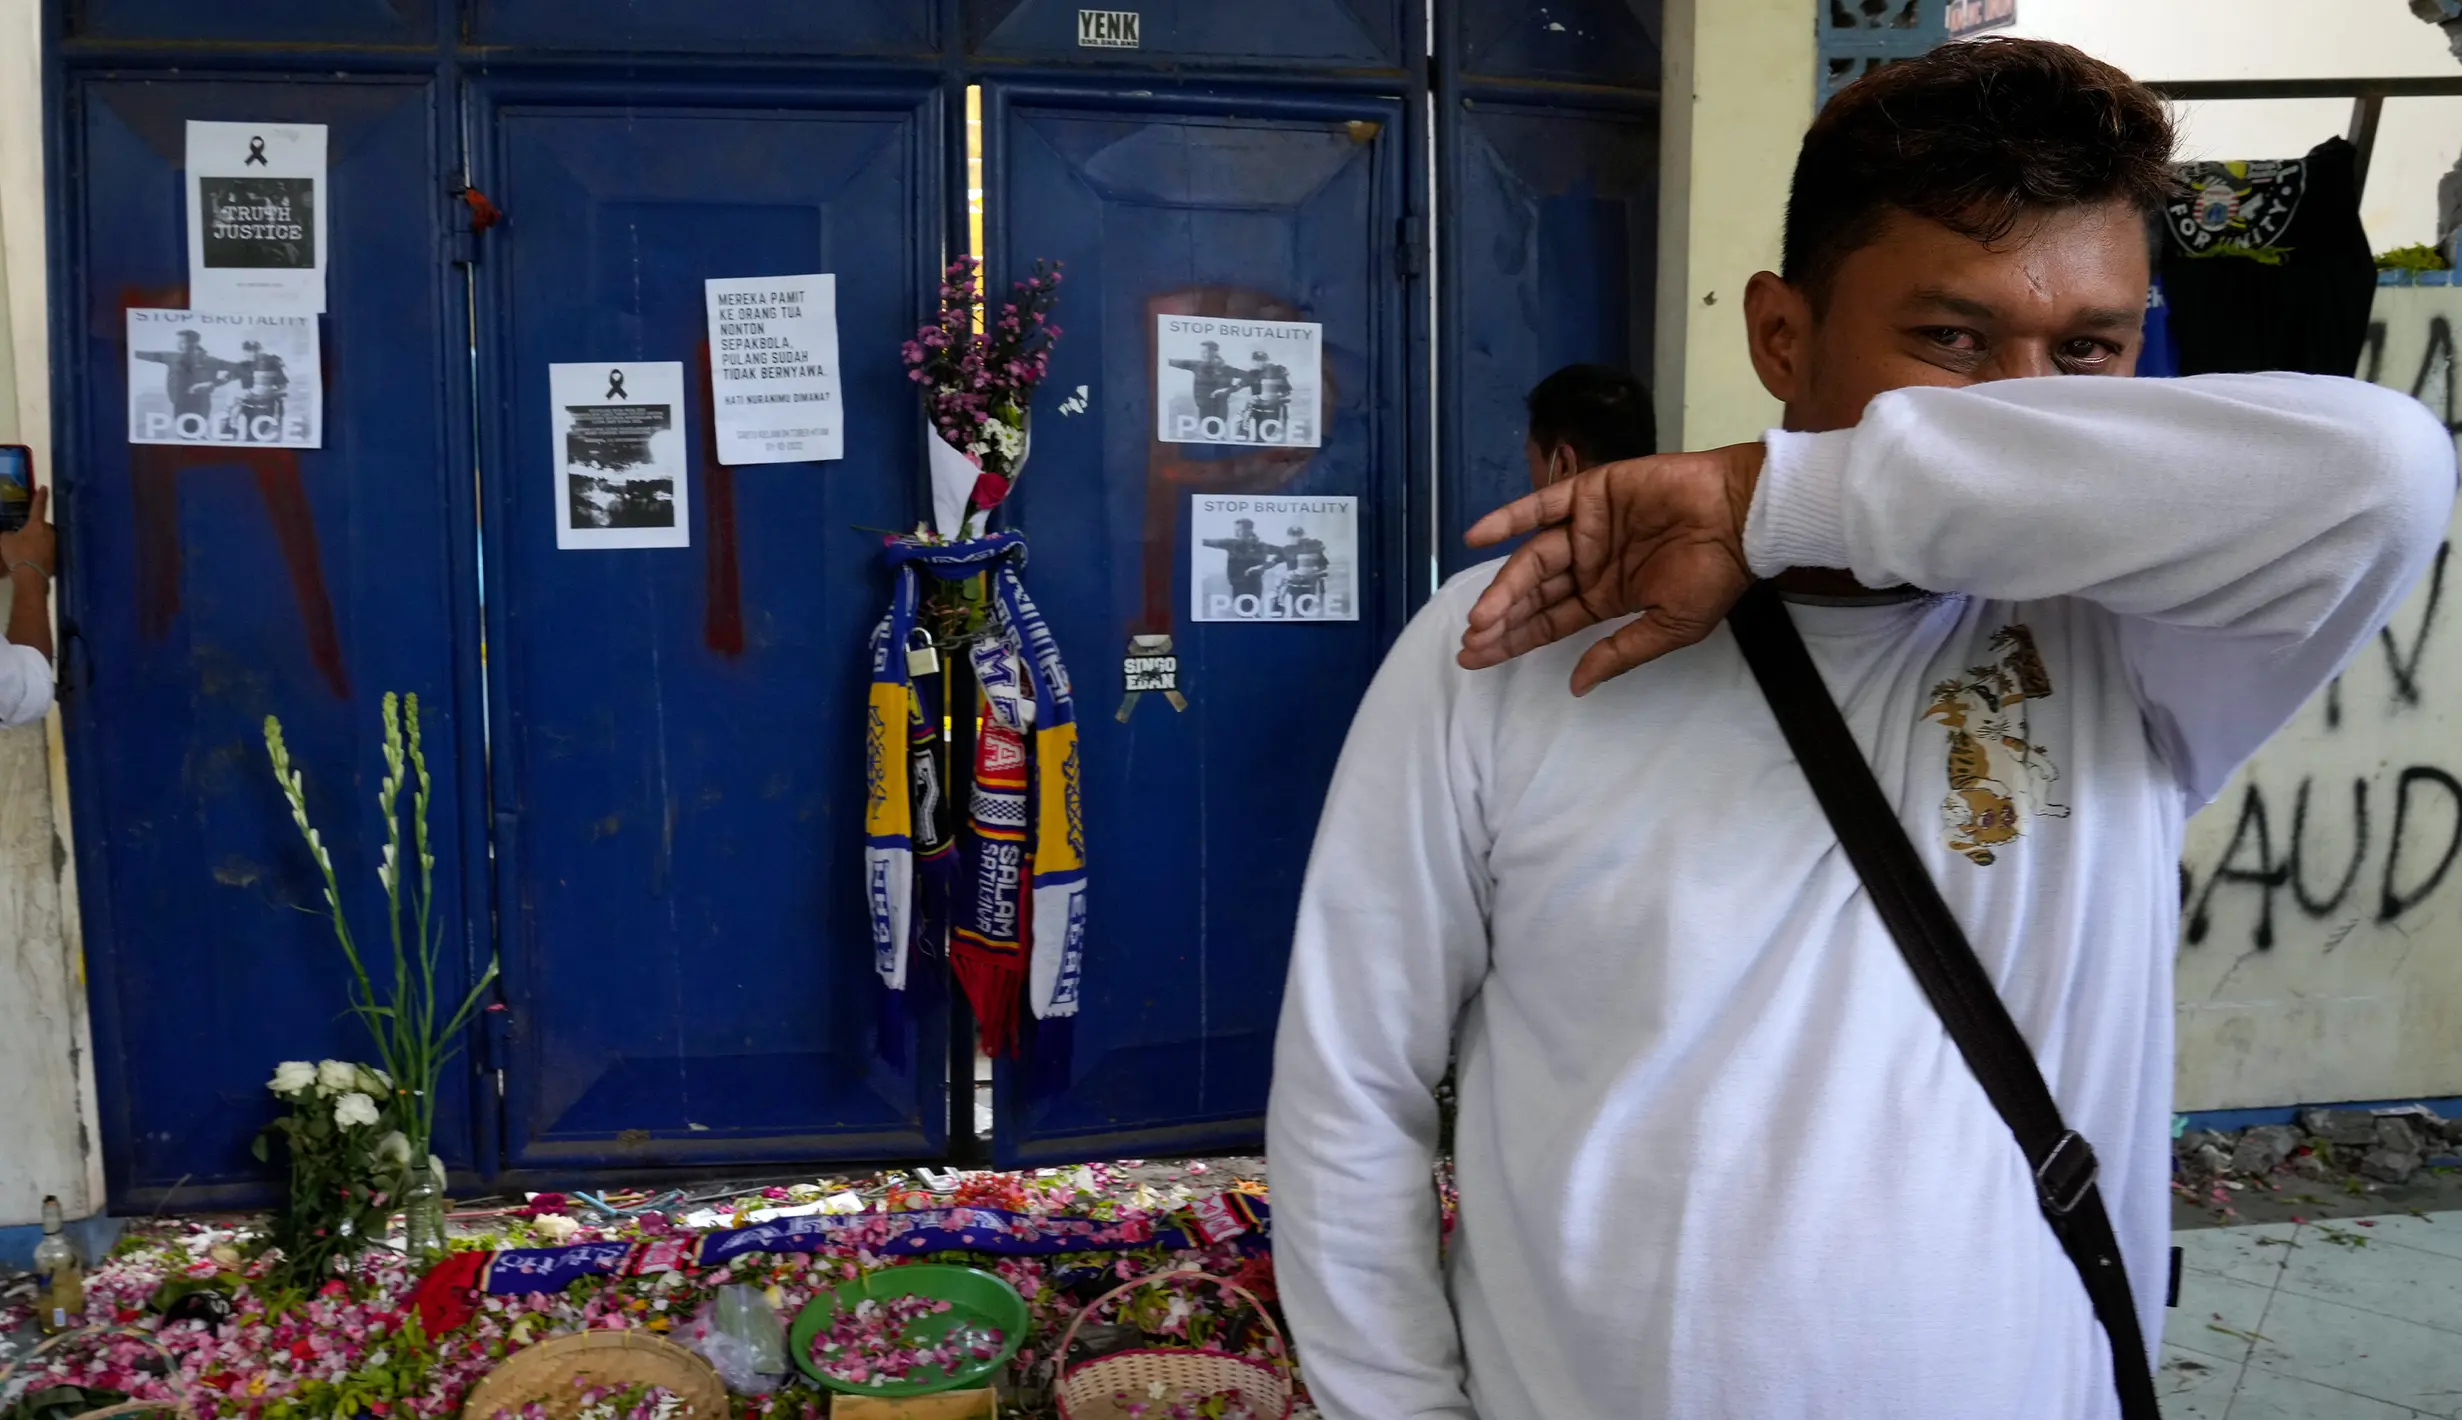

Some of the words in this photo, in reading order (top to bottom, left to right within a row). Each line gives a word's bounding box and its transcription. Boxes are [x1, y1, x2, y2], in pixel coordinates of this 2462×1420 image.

[1080, 12, 1138, 40] YENK
[221, 205, 292, 222] TRUTH
[213, 223, 303, 240] JUSTICE
[2169, 203, 2212, 249] FOR
[718, 292, 767, 306] MEREKA
[771, 290, 805, 304] PAMIT
[135, 311, 194, 323] STOP
[201, 314, 309, 327] BRUTALITY
[719, 308, 735, 321] KE
[738, 306, 777, 320] ORANG
[781, 306, 802, 319] TUA
[720, 322, 765, 336] NONTON
[1169, 320, 1215, 335] STOP
[1219, 324, 1314, 341] BRUTALITY
[722, 352, 768, 365] PULANG
[771, 350, 809, 364] SUDAH
[723, 367, 757, 381] TIDAK
[144, 411, 306, 443] POLICE
[1176, 414, 1307, 443] POLICE
[1204, 500, 1249, 513] STOP
[1254, 501, 1349, 514] BRUTALITY
[1209, 593, 1343, 618] POLICE
[1124, 656, 1177, 674] SINGO
[2181, 766, 2462, 952] AUD
[991, 844, 1021, 938] SALAM
